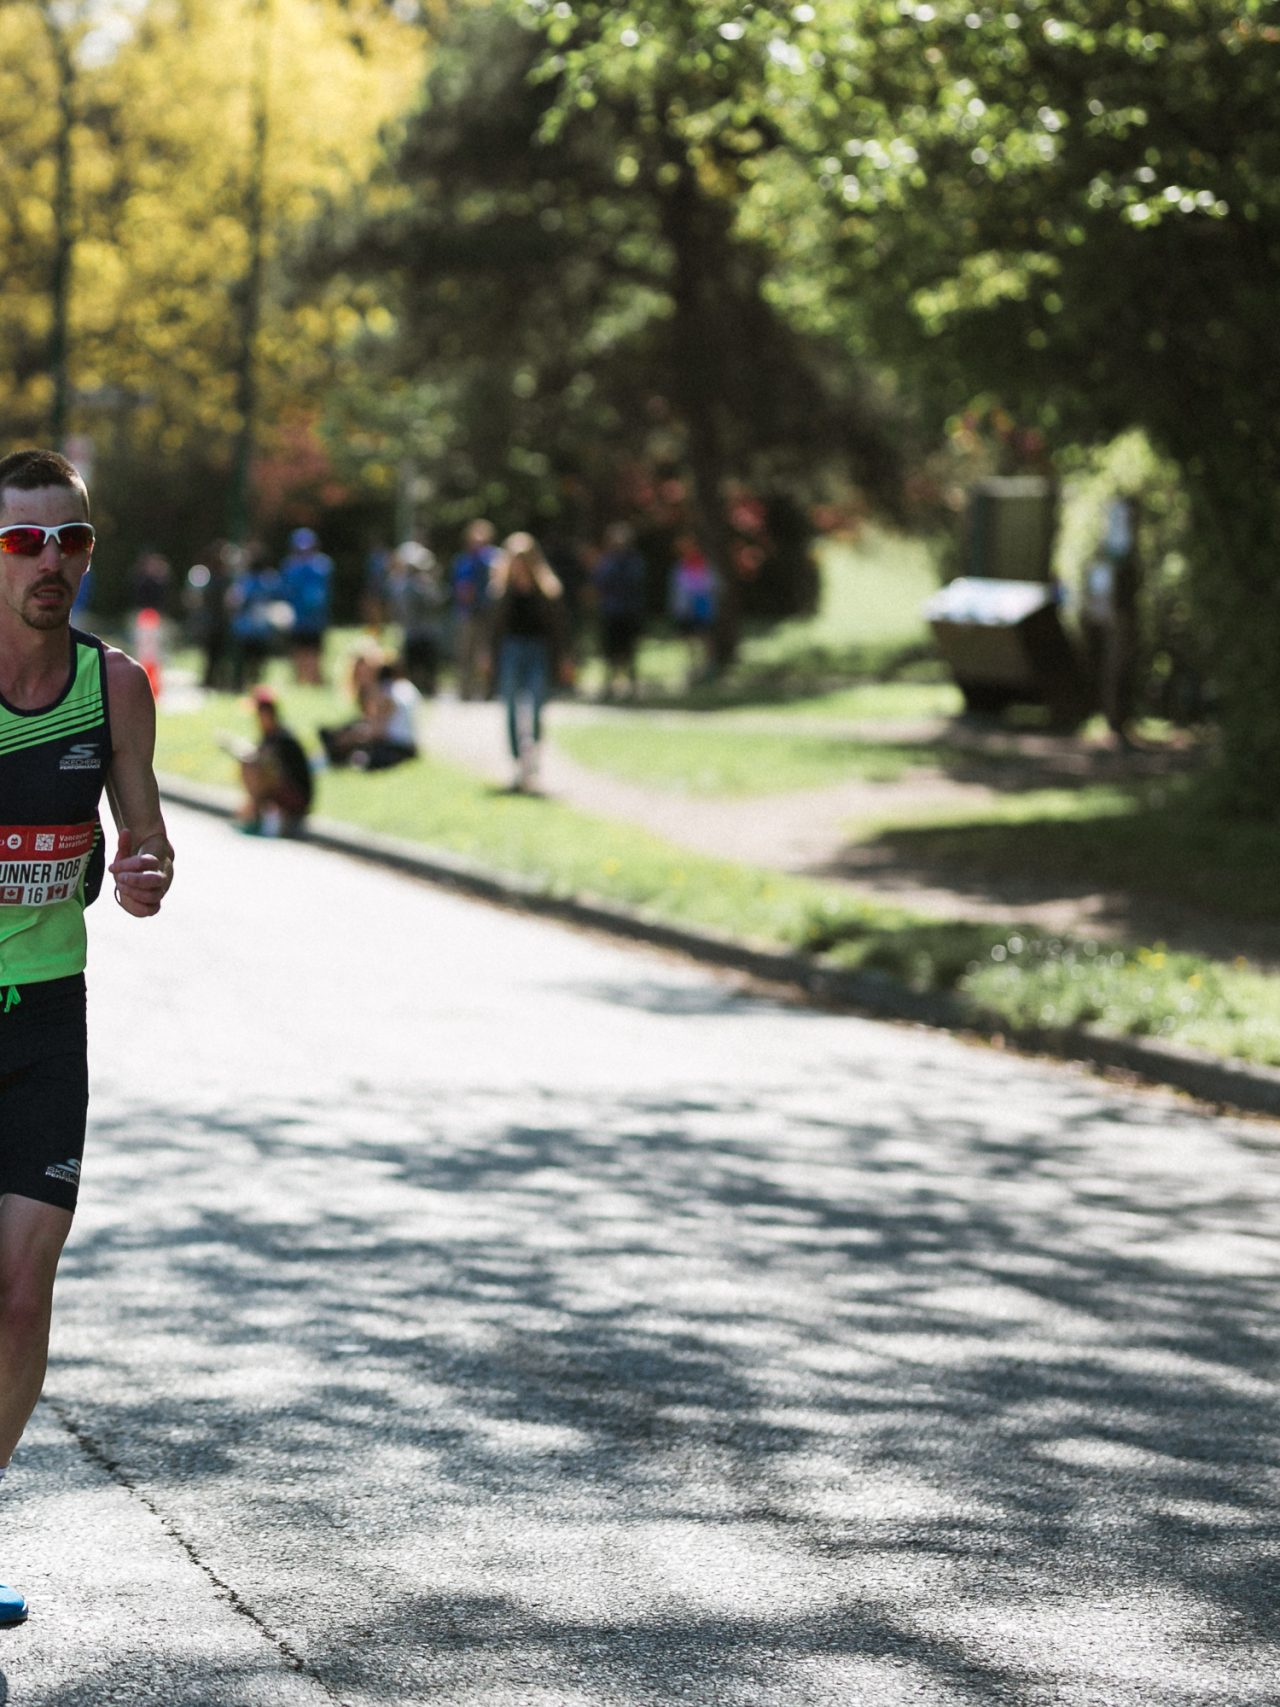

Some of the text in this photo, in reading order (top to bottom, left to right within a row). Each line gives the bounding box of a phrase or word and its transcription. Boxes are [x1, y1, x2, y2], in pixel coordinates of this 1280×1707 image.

[59, 831, 91, 841] Vancouver
[58, 838, 88, 848] Marathon
[54, 859, 81, 882] ROB
[27, 887, 44, 904] 16
